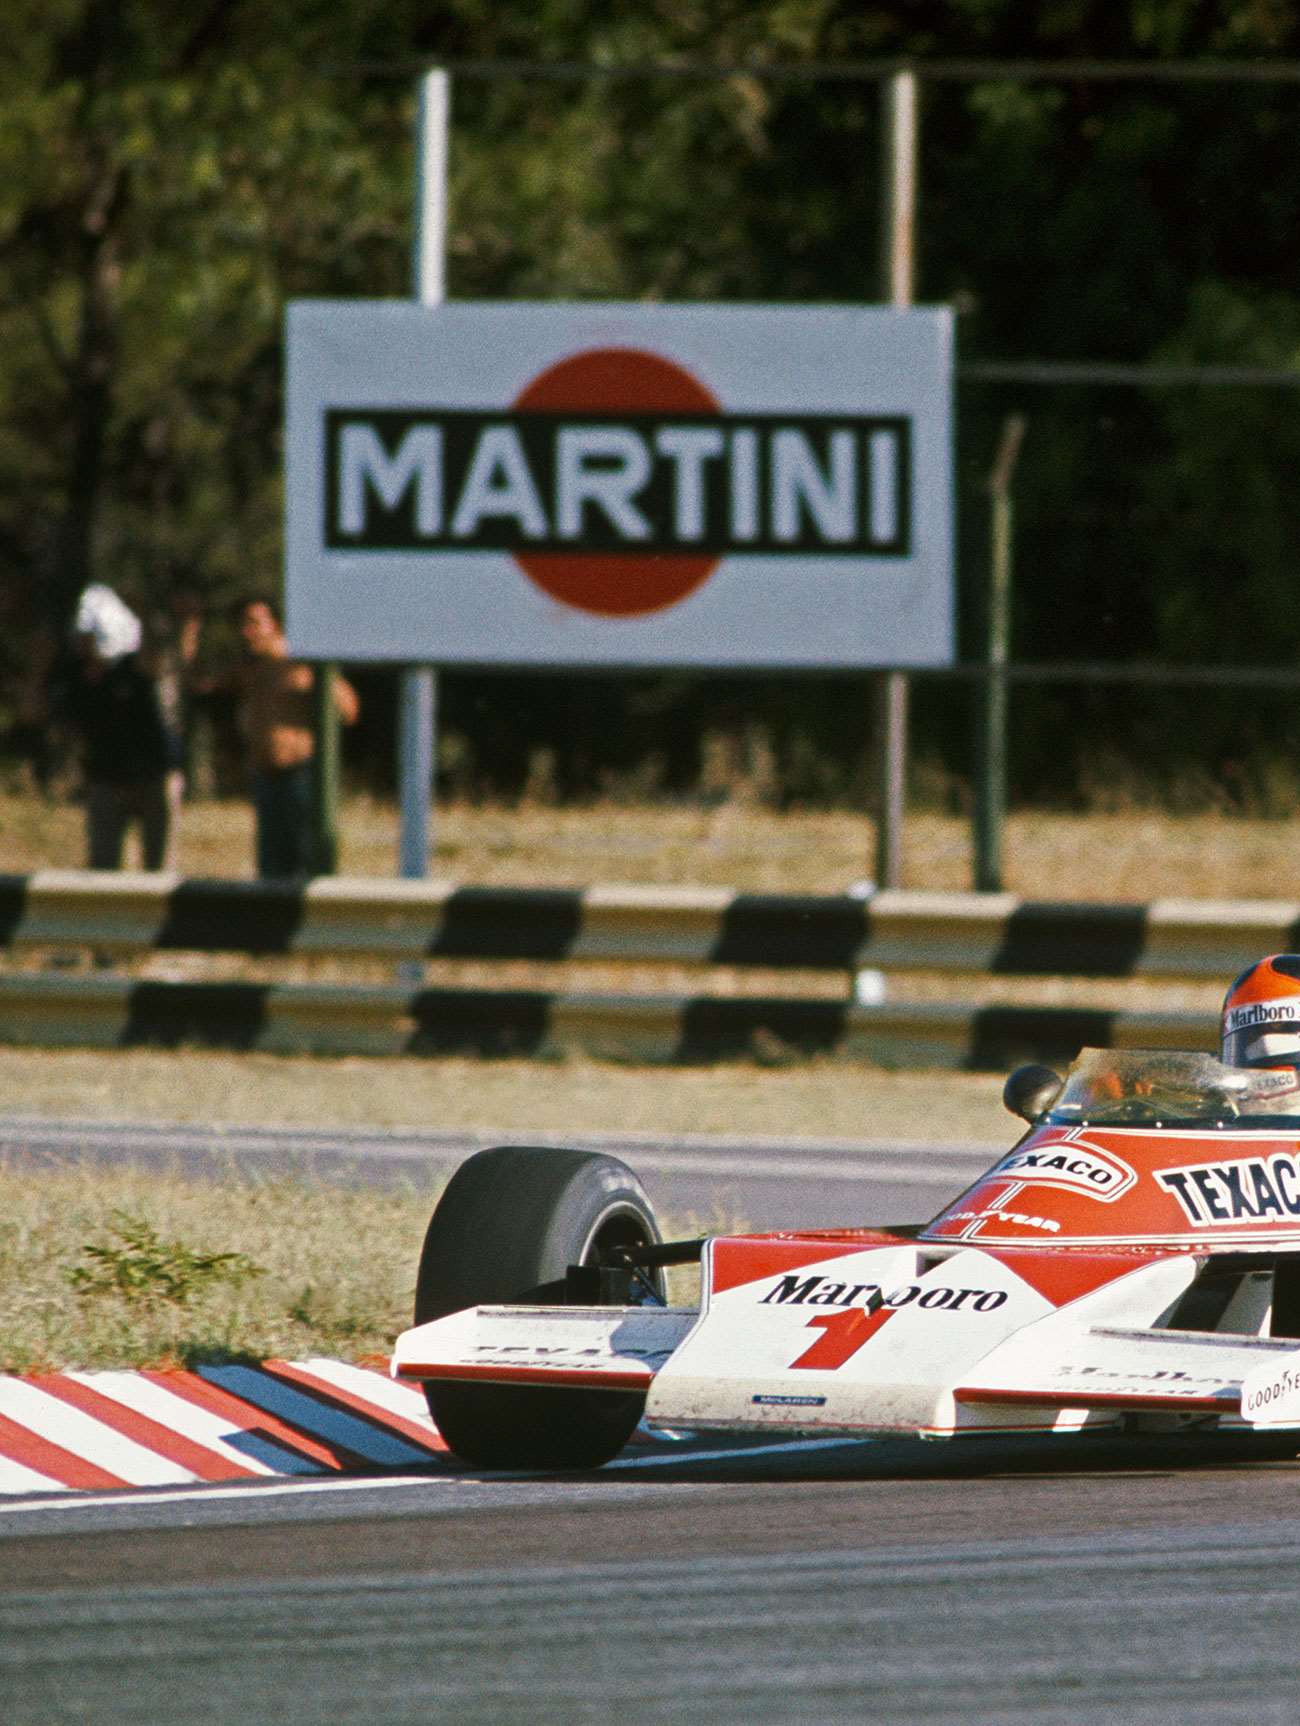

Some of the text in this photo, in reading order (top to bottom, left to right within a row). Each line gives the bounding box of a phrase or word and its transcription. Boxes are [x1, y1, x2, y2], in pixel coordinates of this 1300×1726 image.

[337, 423, 898, 543] MARTINI
[1230, 1003, 1295, 1024] Marlboro
[1001, 1154, 1113, 1185] EXACO
[757, 1275, 1009, 1313] Marboro
[787, 1307, 899, 1371] 1
